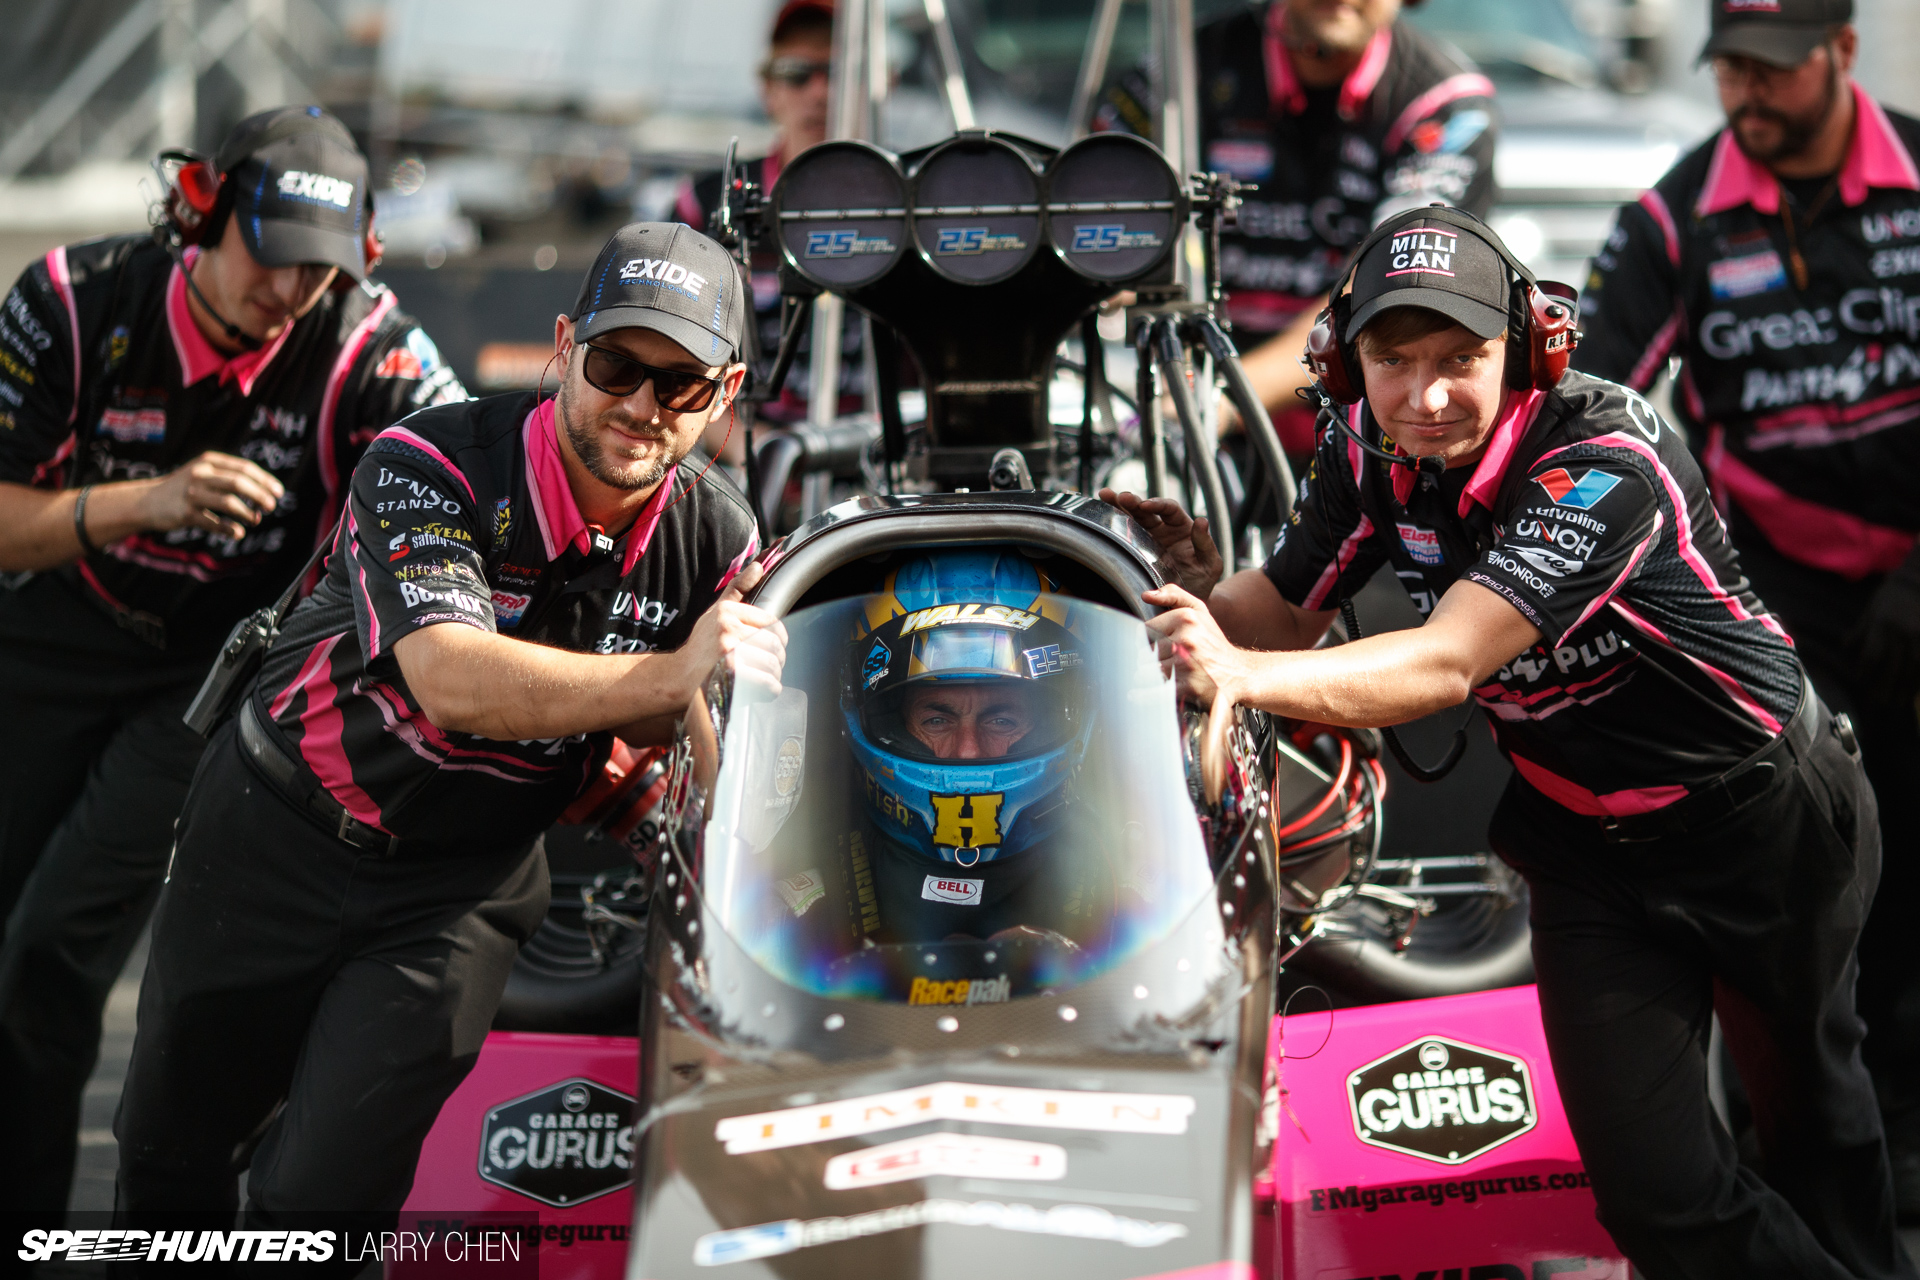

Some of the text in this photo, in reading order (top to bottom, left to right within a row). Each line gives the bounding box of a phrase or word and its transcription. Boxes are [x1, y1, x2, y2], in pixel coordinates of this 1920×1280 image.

[277, 170, 353, 208] EXIDE
[935, 227, 989, 256] 25
[1070, 224, 1126, 253] 25
[1862, 208, 1920, 243] UNO
[804, 229, 860, 258] 25
[1390, 234, 1456, 254] MILLI
[619, 259, 705, 296] EXIDE
[1392, 251, 1450, 271] CAN
[618, 278, 699, 302] TECHNOLOGIES
[1516, 518, 1597, 561] UNOH
[1493, 554, 1550, 598] MONROE
[612, 589, 679, 628] UNOH
[898, 604, 1040, 638] WALSH
[1023, 644, 1063, 678] 25
[931, 792, 1005, 848] H
[937, 880, 970, 895] BELL
[909, 973, 1010, 1006] Racepak
[1393, 1067, 1485, 1090] GARAGE
[1358, 1077, 1527, 1132] GURUS
[528, 1113, 619, 1130] GARAGE
